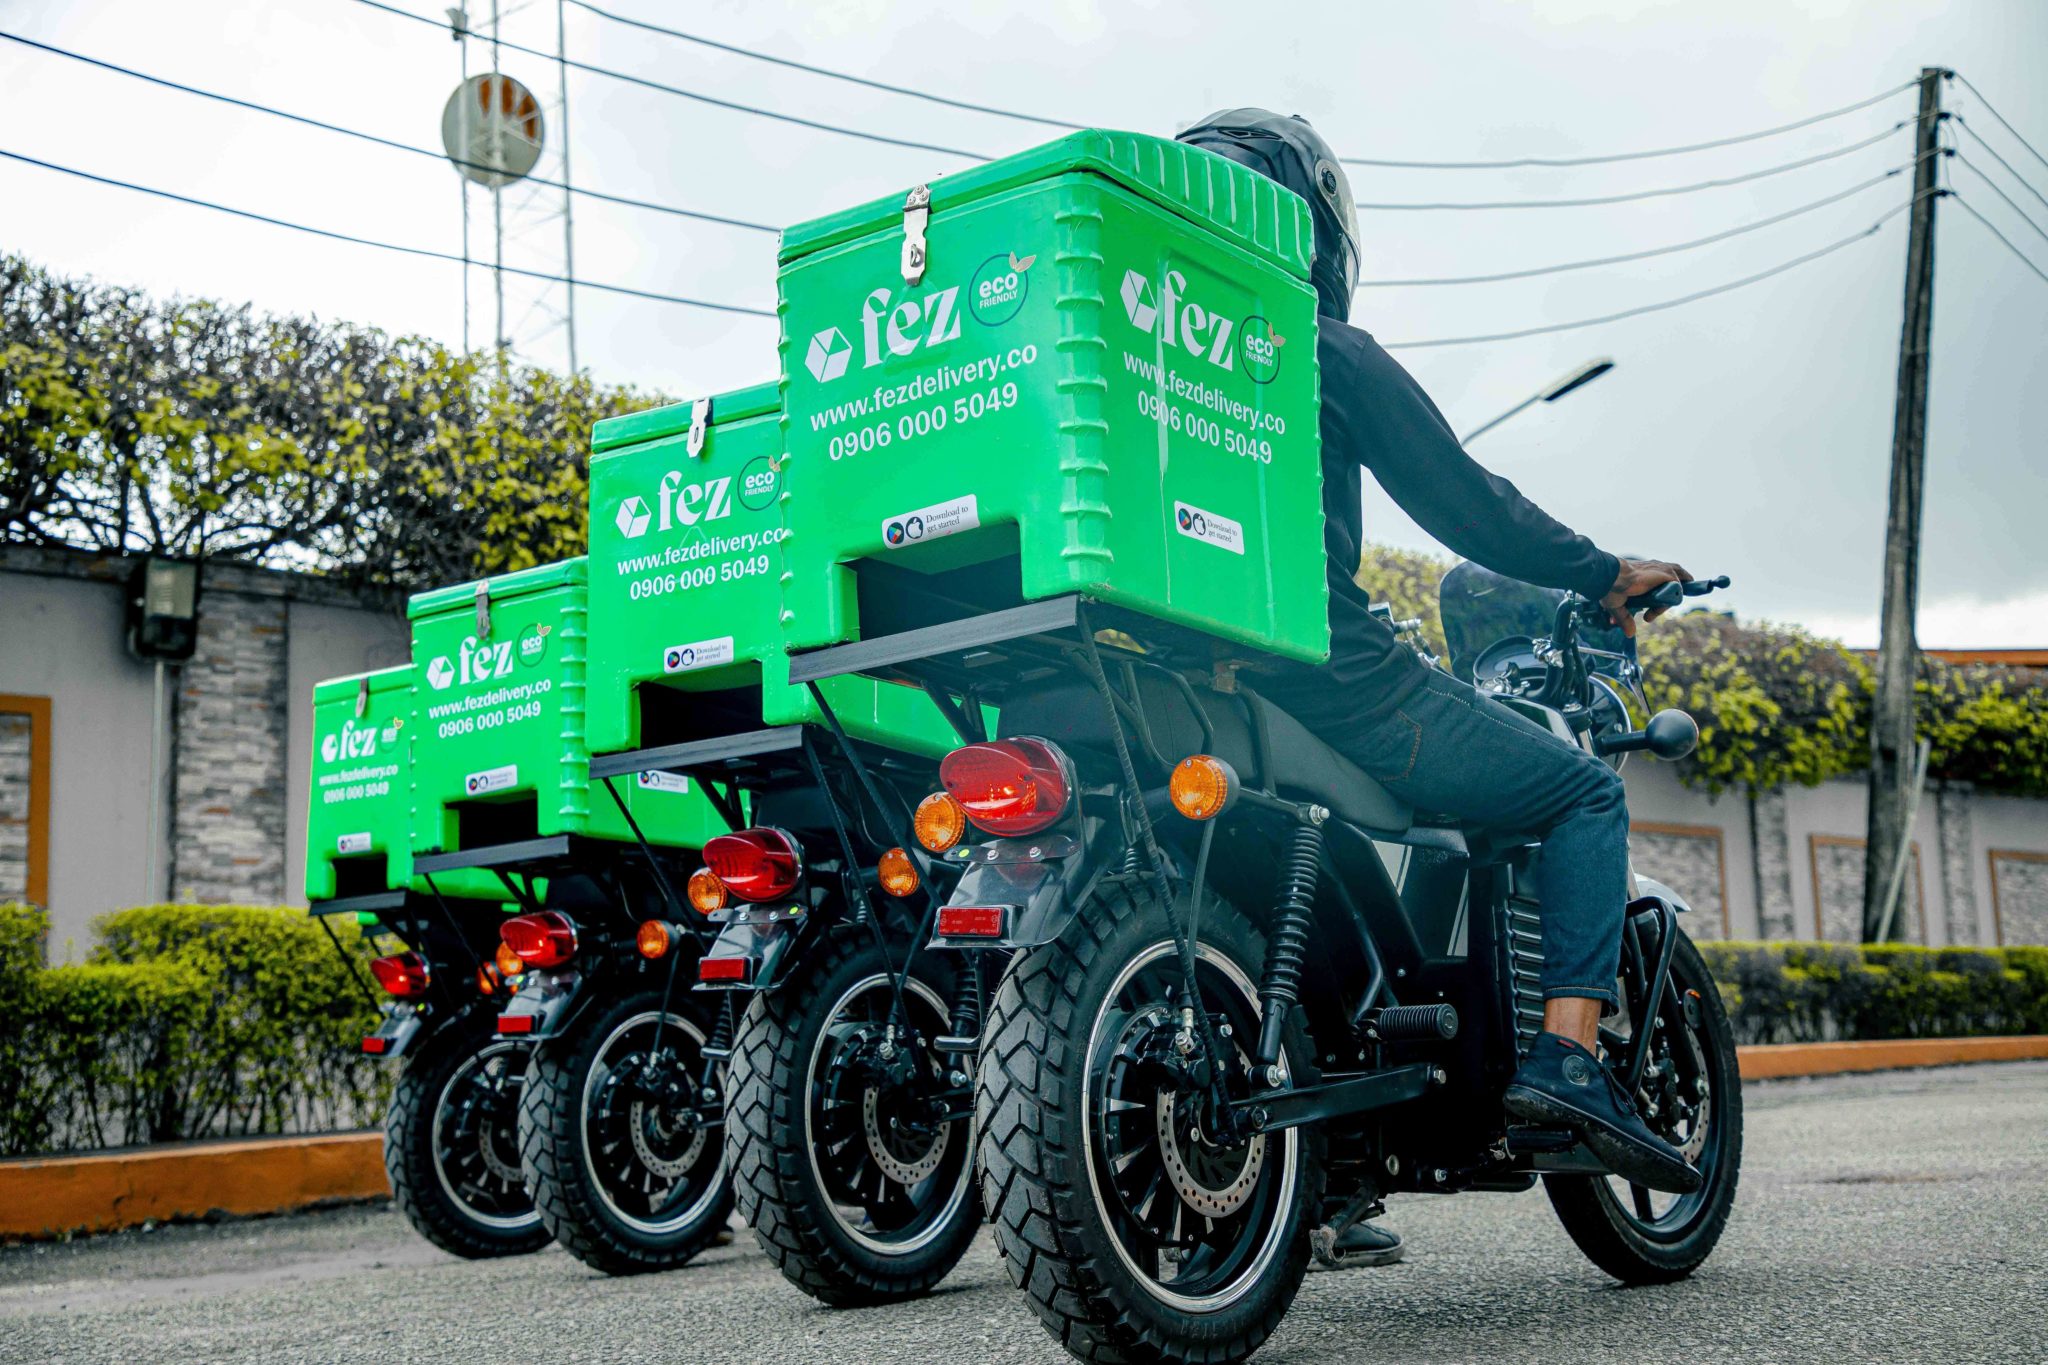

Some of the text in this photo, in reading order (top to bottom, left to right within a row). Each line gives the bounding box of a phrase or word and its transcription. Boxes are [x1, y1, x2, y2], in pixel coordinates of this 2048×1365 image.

[979, 272, 1018, 298] eco
[979, 289, 1018, 309] FRIENDLY
[860, 287, 961, 369] fez
[1161, 270, 1234, 372] fez
[1245, 334, 1273, 357] eco
[1245, 350, 1273, 367] FRIENDLY
[810, 345, 1038, 431] www.fezdelivery.co
[1123, 351, 1286, 435] www.fezdelivery.co
[829, 382, 1019, 461] 0906 000 5049
[1137, 390, 1272, 465] 0906 000 5049
[745, 471, 775, 488] eco
[657, 470, 732, 532] fez
[926, 506, 969, 523] Download to
[926, 517, 960, 533] get started
[617, 528, 784, 576] www.fezdelivery.co
[630, 555, 769, 600] 0906 000 5049
[459, 636, 514, 685] fez
[522, 635, 542, 650] eco
[428, 679, 551, 719] www.fezdelivery.co
[339, 720, 377, 760] fez
[438, 701, 541, 739] 0906 000 5049
